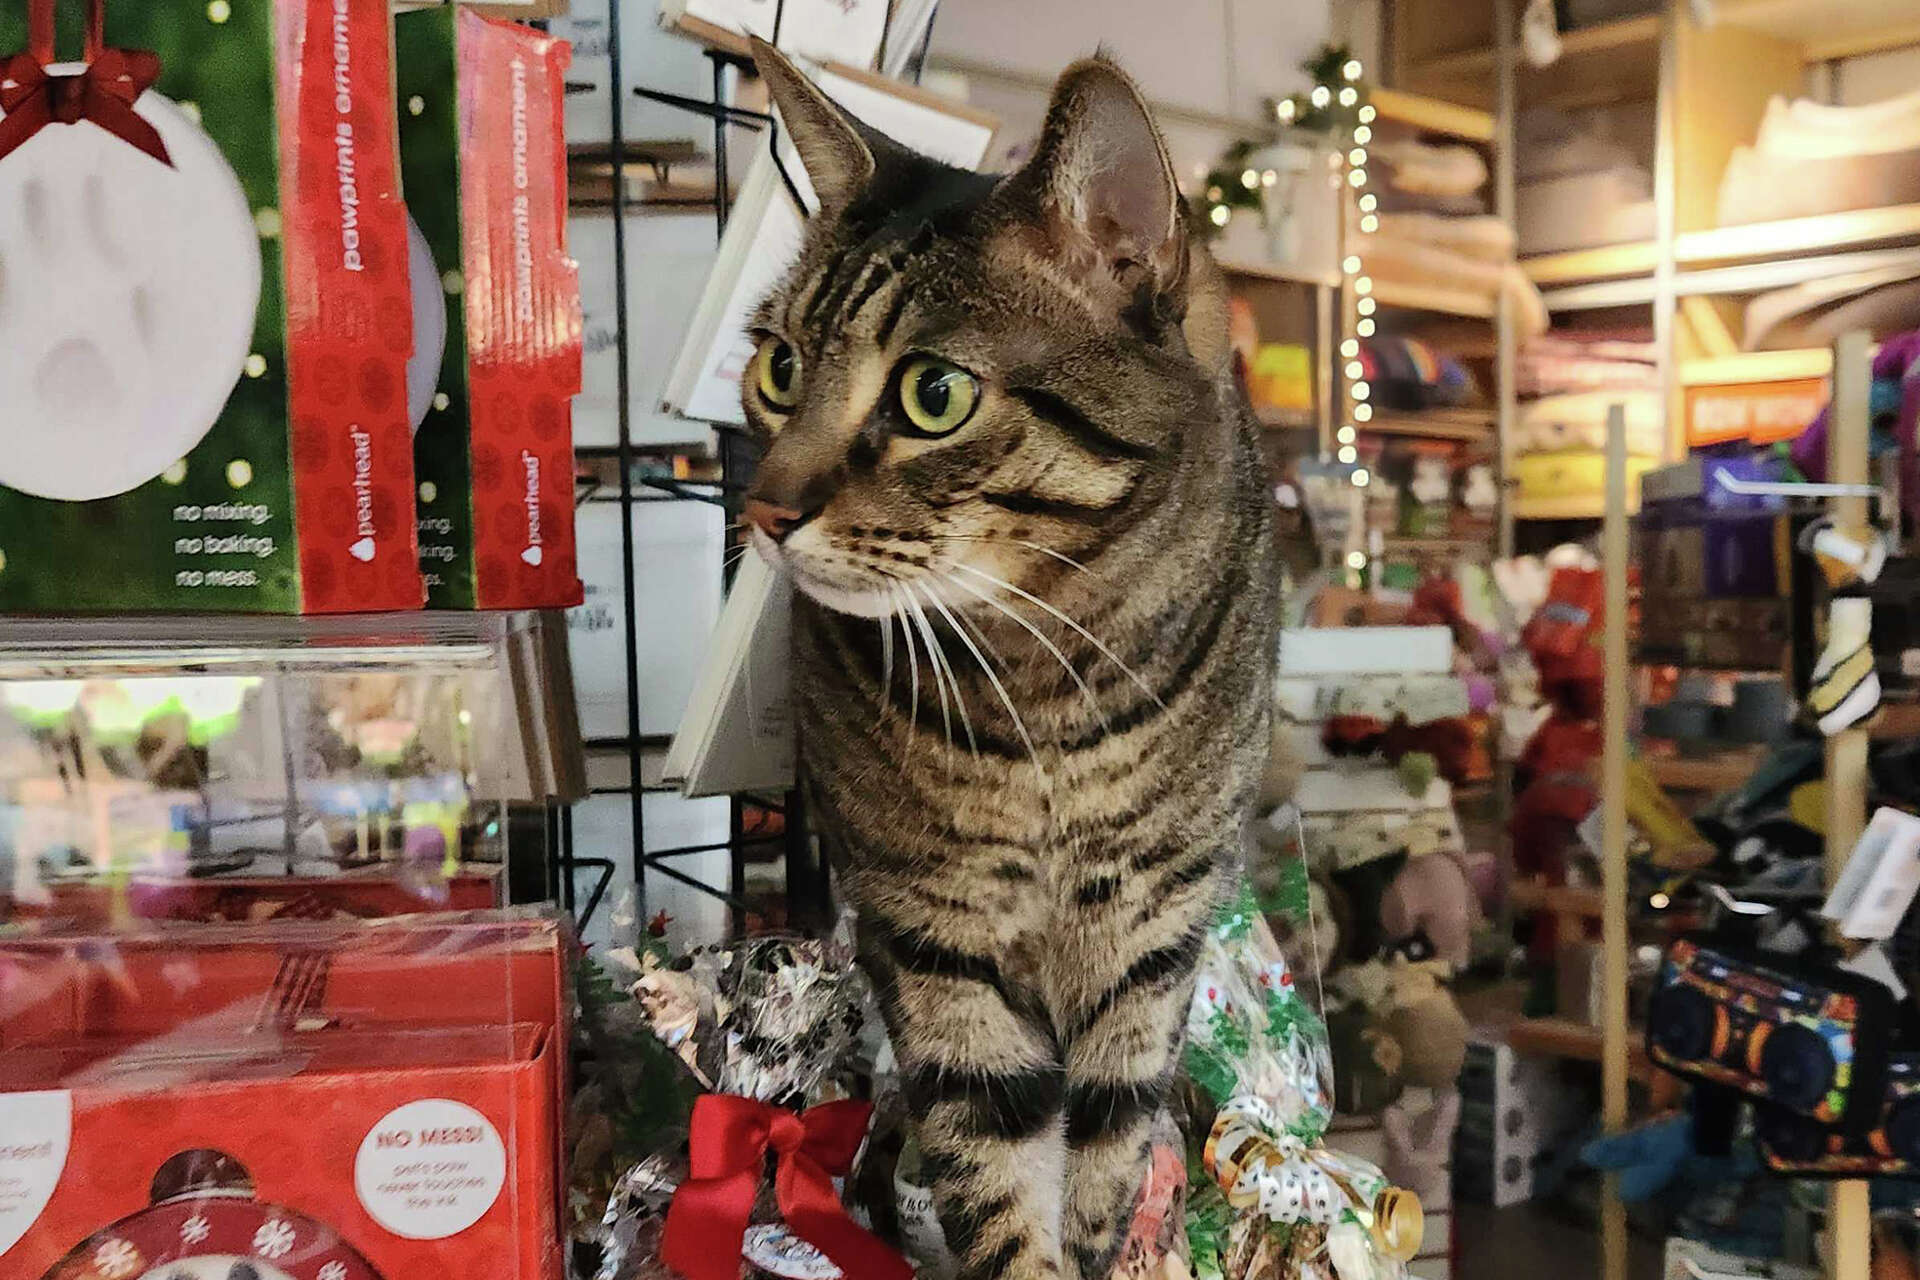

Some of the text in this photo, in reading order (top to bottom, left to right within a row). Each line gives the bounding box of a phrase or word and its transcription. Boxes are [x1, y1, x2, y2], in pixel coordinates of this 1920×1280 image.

[334, 122, 365, 272] pawprints
[510, 56, 534, 323] pawprints ornament
[173, 501, 274, 526] no mixing.
[175, 534, 278, 558] no baking.
[175, 570, 261, 587] no mess.
[376, 1129, 413, 1150] NO
